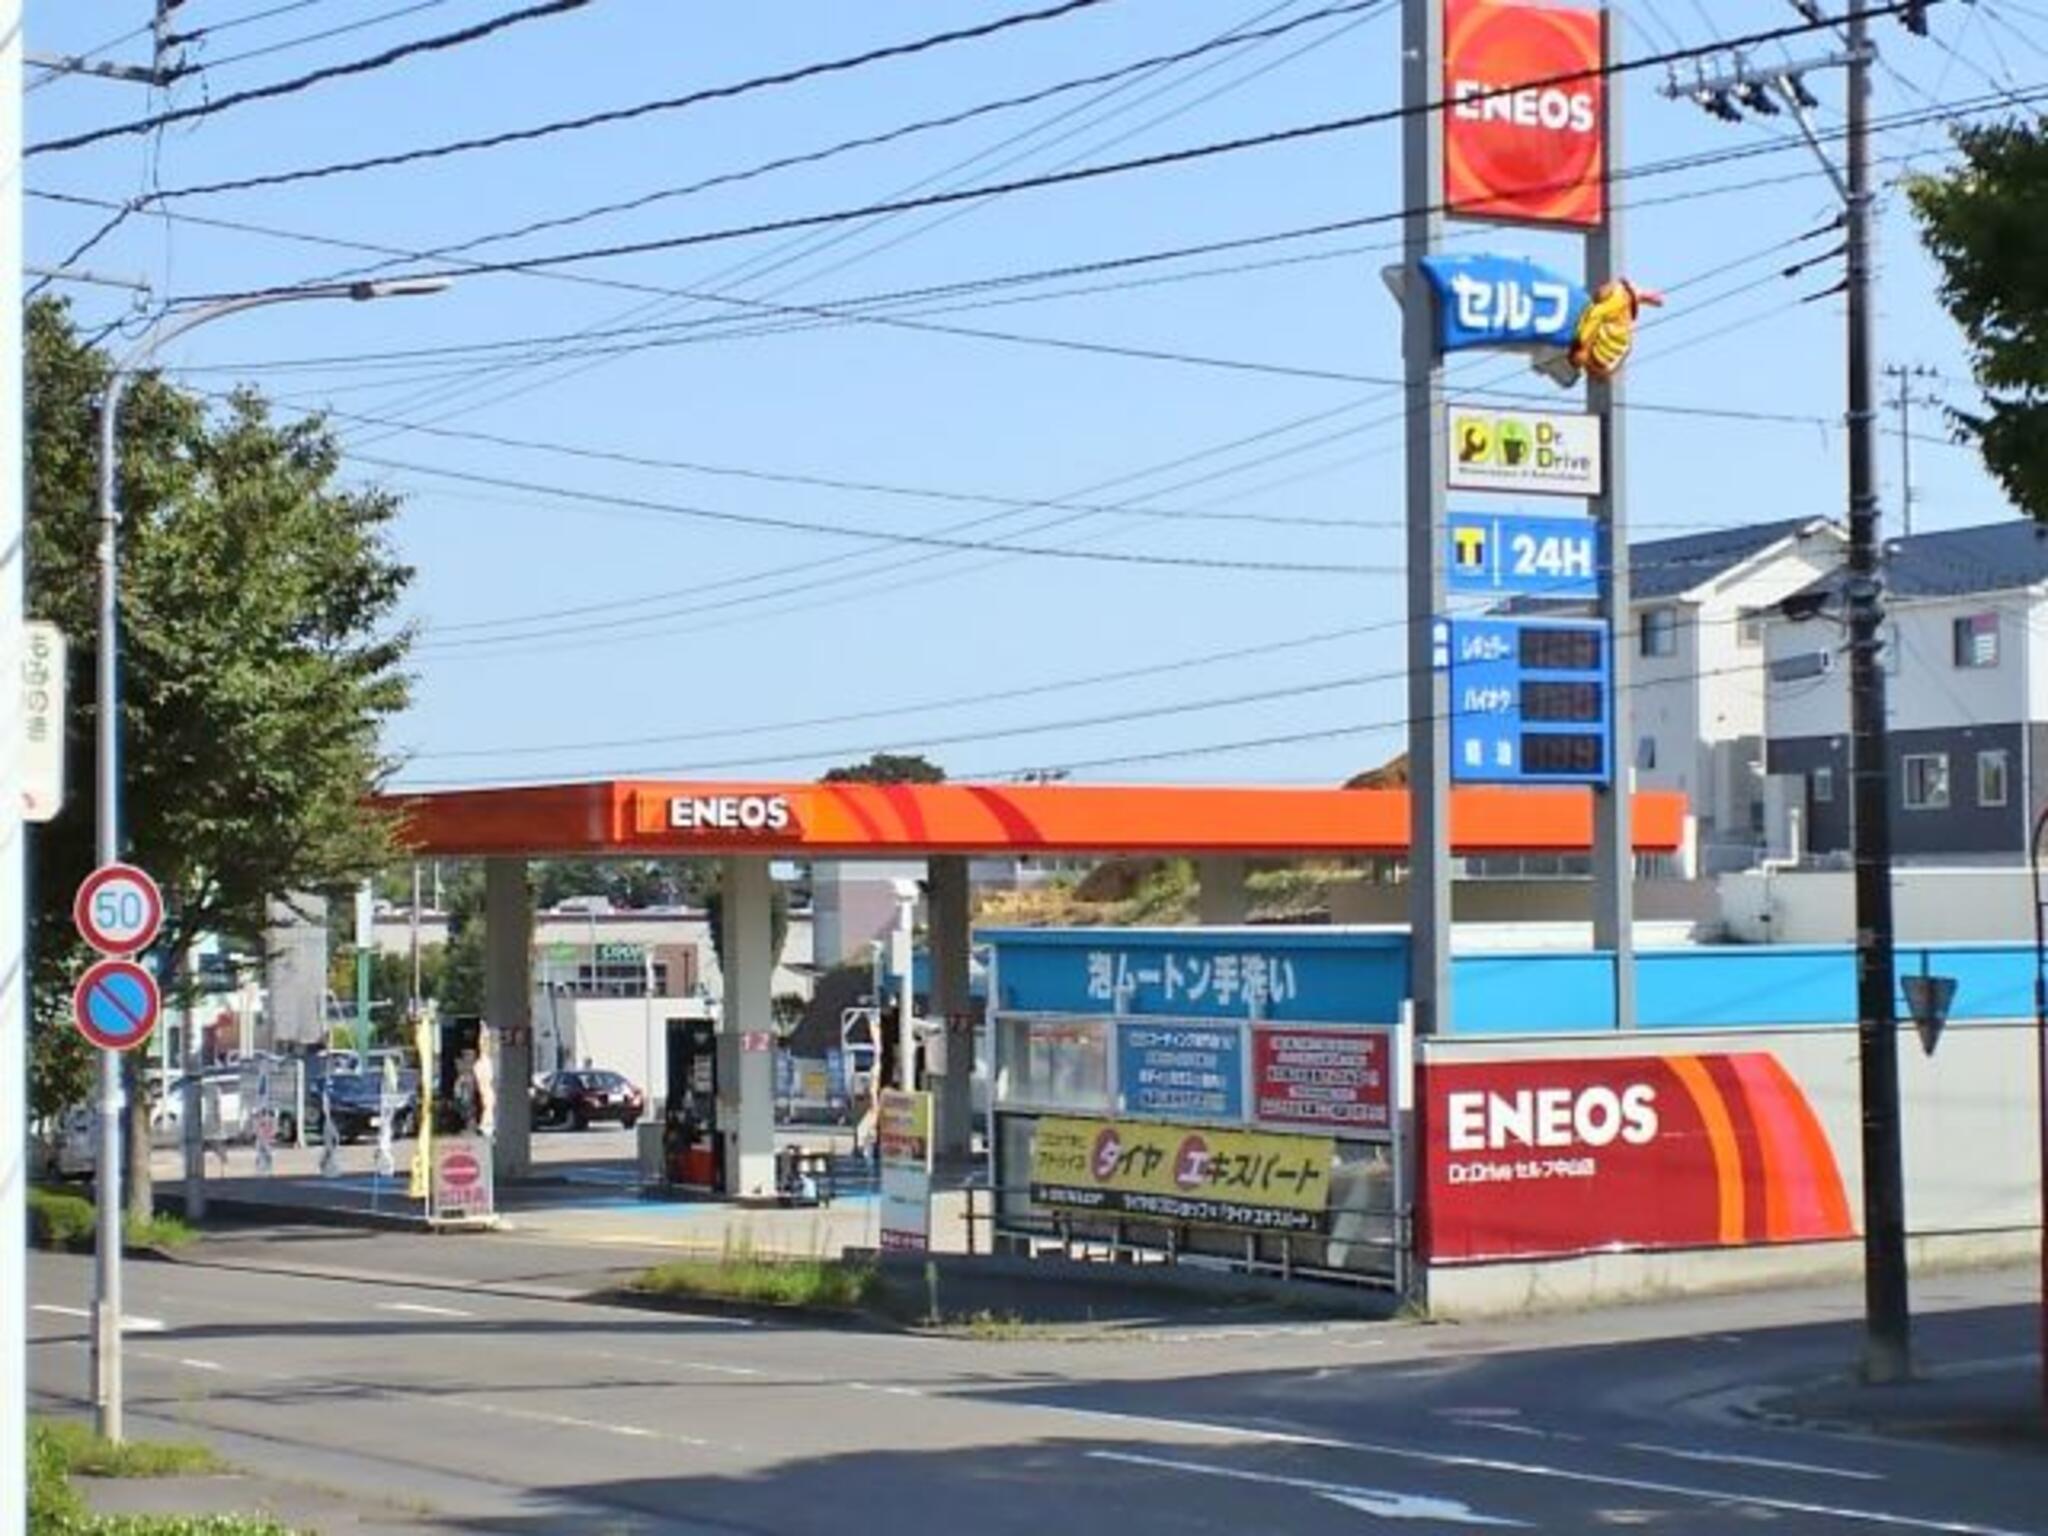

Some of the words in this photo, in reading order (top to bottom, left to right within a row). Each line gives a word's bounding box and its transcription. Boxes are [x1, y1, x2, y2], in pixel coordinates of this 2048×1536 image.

[1454, 80, 1594, 131] ENEOS
[1452, 274, 1569, 332] セルフ
[1537, 447, 1591, 471] Drive
[1511, 534, 1592, 577] 24H
[671, 795, 789, 830] ENEOS
[96, 891, 142, 930] 50
[1088, 952, 1297, 1005] 泡ムートン手洗い
[1448, 1083, 1659, 1151] ENEOS
